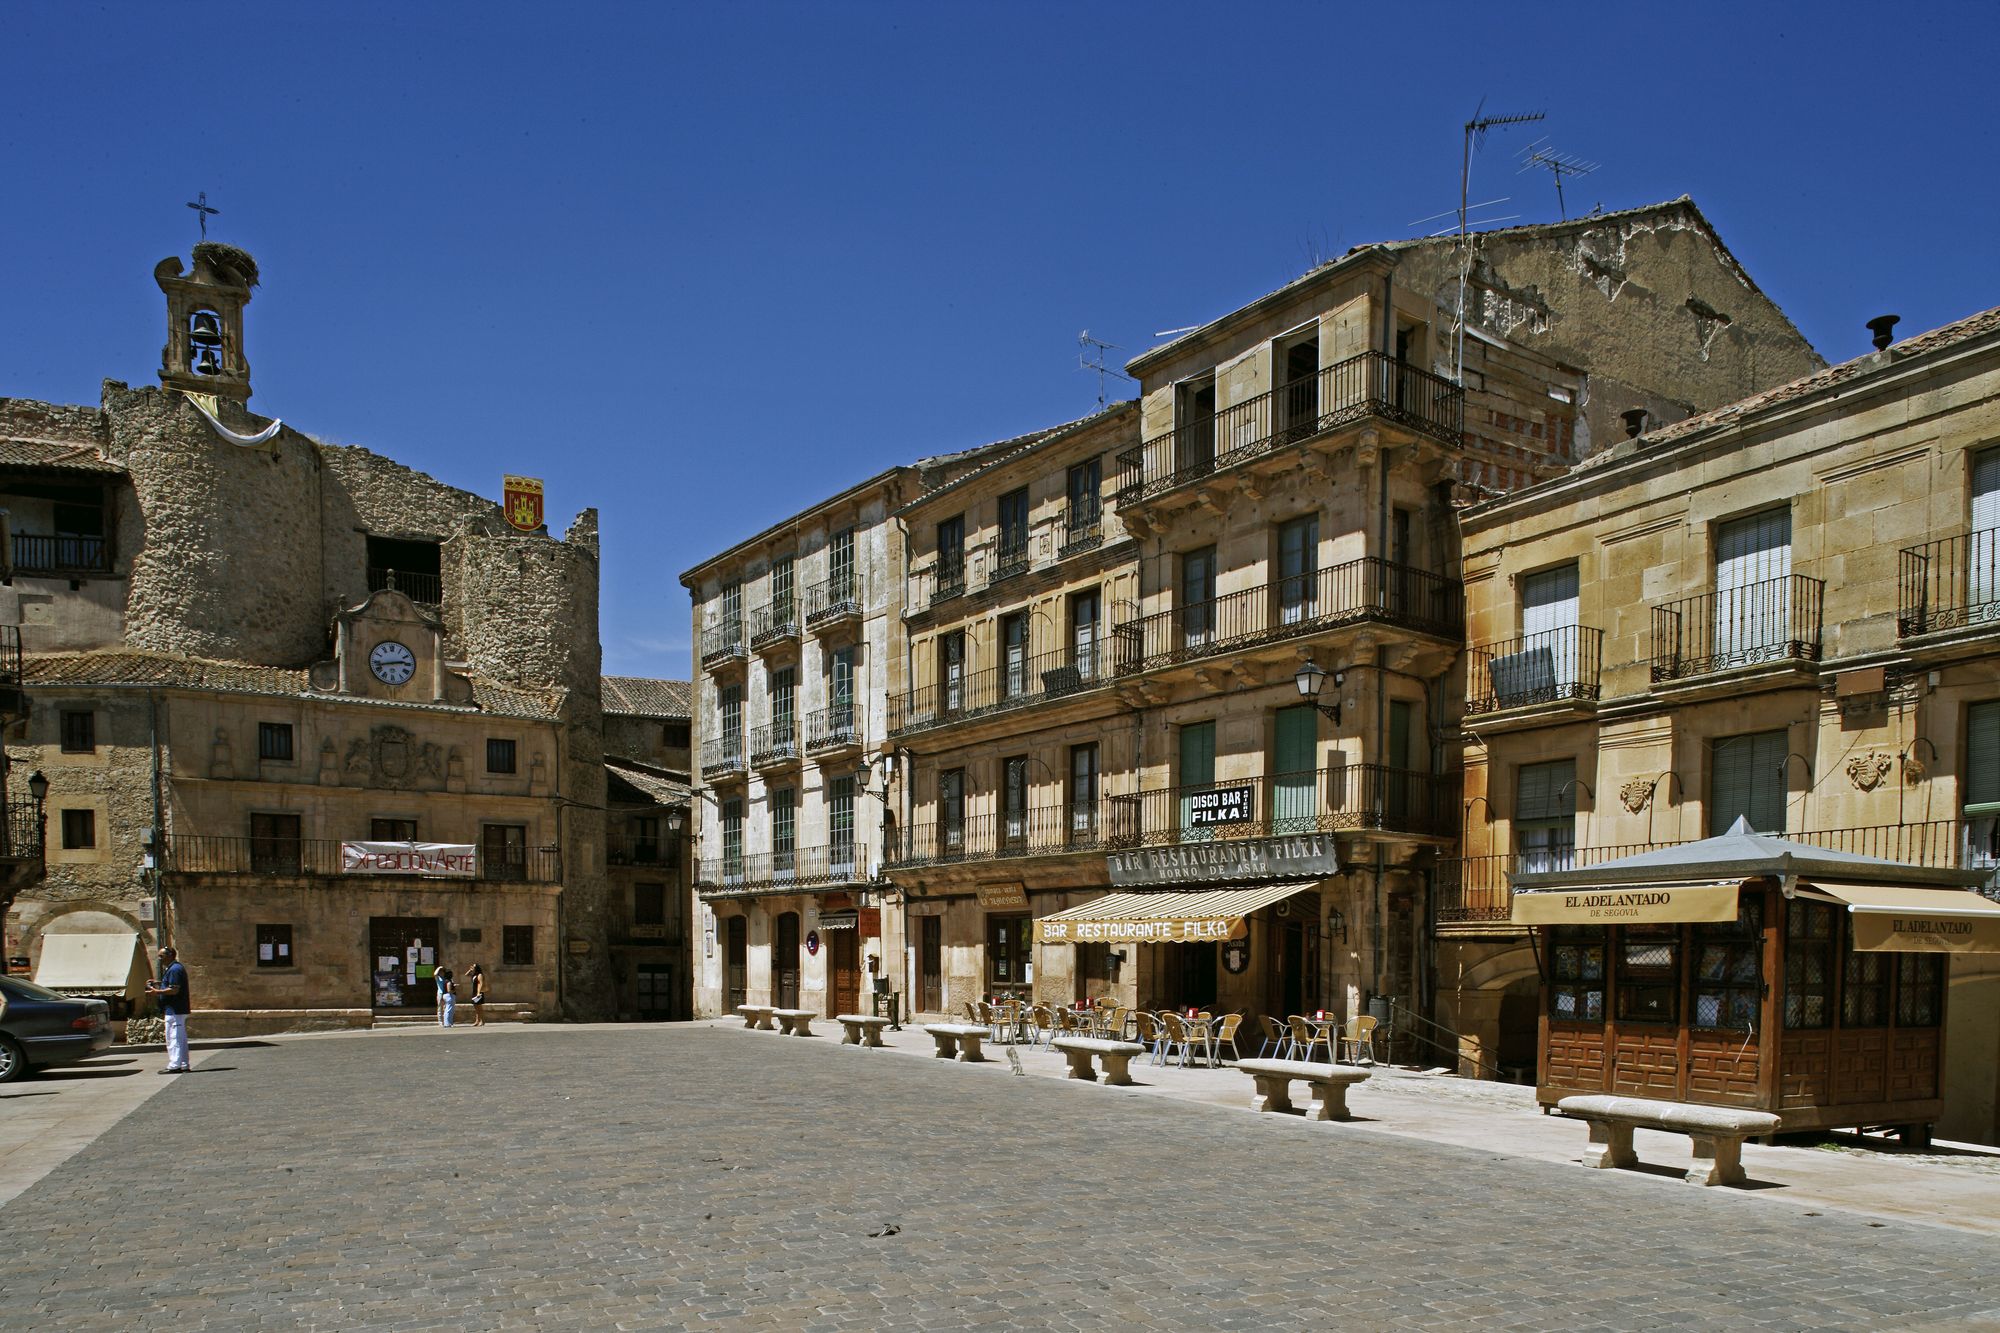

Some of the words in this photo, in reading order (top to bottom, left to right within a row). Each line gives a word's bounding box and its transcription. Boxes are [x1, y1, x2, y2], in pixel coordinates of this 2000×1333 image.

[1192, 793, 1219, 809] DISCO
[1222, 791, 1241, 806] BAR
[1192, 807, 1240, 823] FILKA
[434, 848, 475, 872] ARTE
[1115, 856, 1142, 872] BAR
[1151, 845, 1259, 868] RESTAURANTE
[1160, 867, 1198, 879] HORNO
[1209, 864, 1225, 875] DE
[1237, 862, 1267, 873] ASAR
[1565, 896, 1580, 908] EL
[1582, 892, 1671, 907] ADELANTADO
[1590, 909, 1601, 917] DE
[1604, 908, 1639, 917] SEGOVIA
[1044, 923, 1068, 938] BAR
[1077, 922, 1172, 938] RESTAURANTE
[1184, 921, 1228, 937] FILKA
[1893, 919, 1906, 933] EL
[1907, 920, 1973, 935] ADELANTADO
